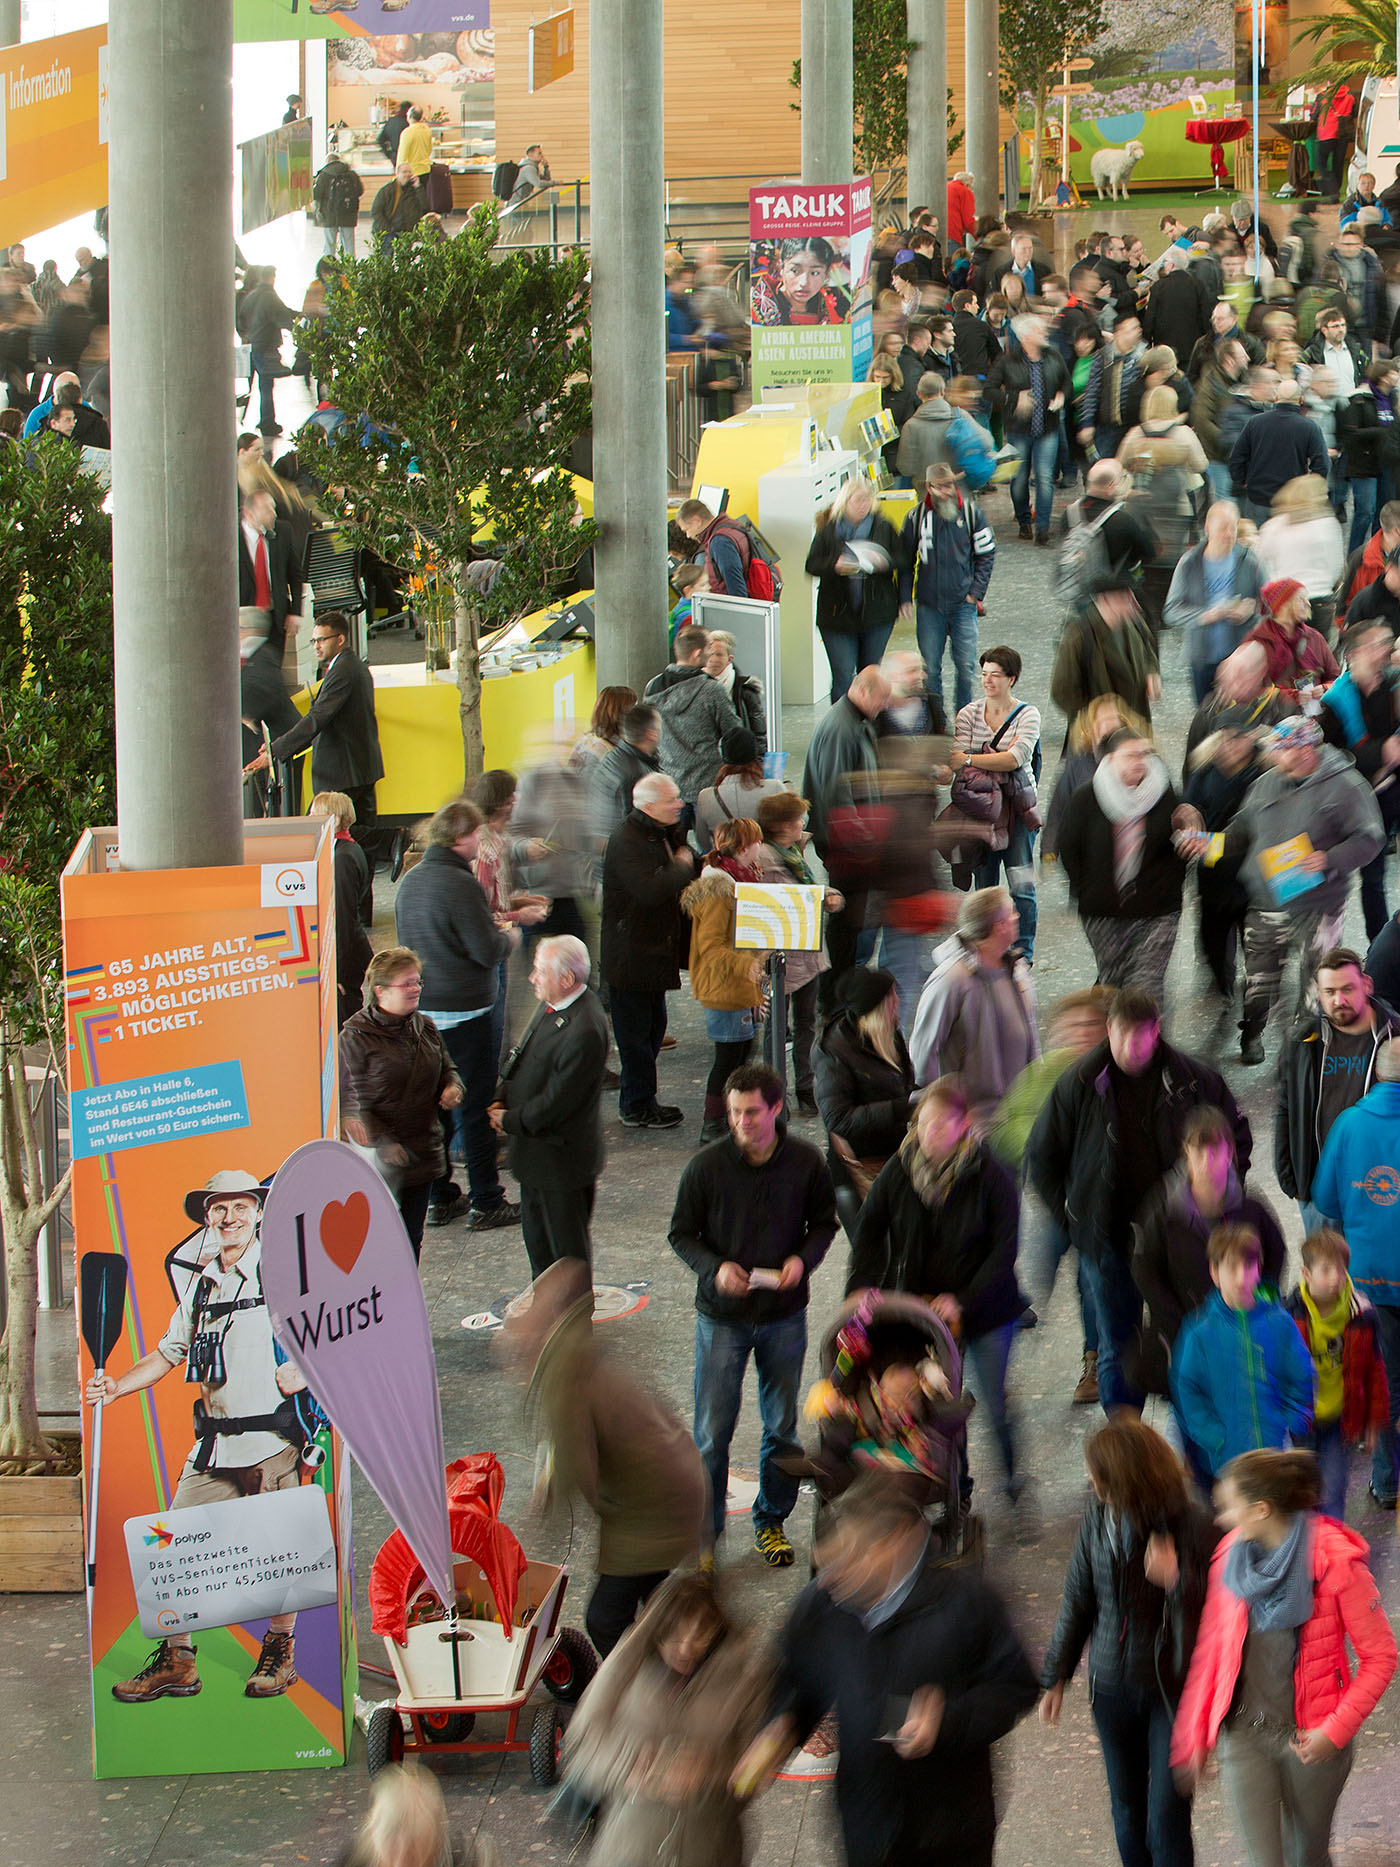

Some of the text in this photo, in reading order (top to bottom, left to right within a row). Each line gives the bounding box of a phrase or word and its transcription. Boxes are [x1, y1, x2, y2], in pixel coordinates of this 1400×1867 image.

[450, 13, 475, 22] vvs.de
[9, 58, 72, 110] Information
[755, 193, 845, 219] TARUK
[758, 345, 846, 361] ASIEN AUSTRALIEN
[761, 331, 795, 346] AFRIKA
[800, 330, 842, 345] AMERIKA
[109, 936, 253, 977] 65 JAHRE ALT,
[94, 953, 277, 1001] 3.893 AUSSTIEGS-
[121, 972, 295, 1018] MÖGLICHKEITEN,
[114, 1010, 203, 1041] 1 TICKET.
[83, 1077, 195, 1107] Jetzt Abo in Halle 6,
[85, 1087, 218, 1121] Stand 6E46 abschließen
[88, 1098, 232, 1134] und Restaurant-Gutschein
[90, 1111, 244, 1148] im Wert von 50 Euro sichern.
[294, 1212, 310, 1297] I
[285, 1285, 384, 1354] Wurst
[174, 1530, 212, 1547] polygo
[149, 1545, 249, 1572] Das netzweite
[152, 1551, 300, 1587] VVS-SeniorenTicket:
[155, 1562, 332, 1601] im Abo nur 45,50€/Monat.
[295, 1746, 332, 1759] vvs.de
